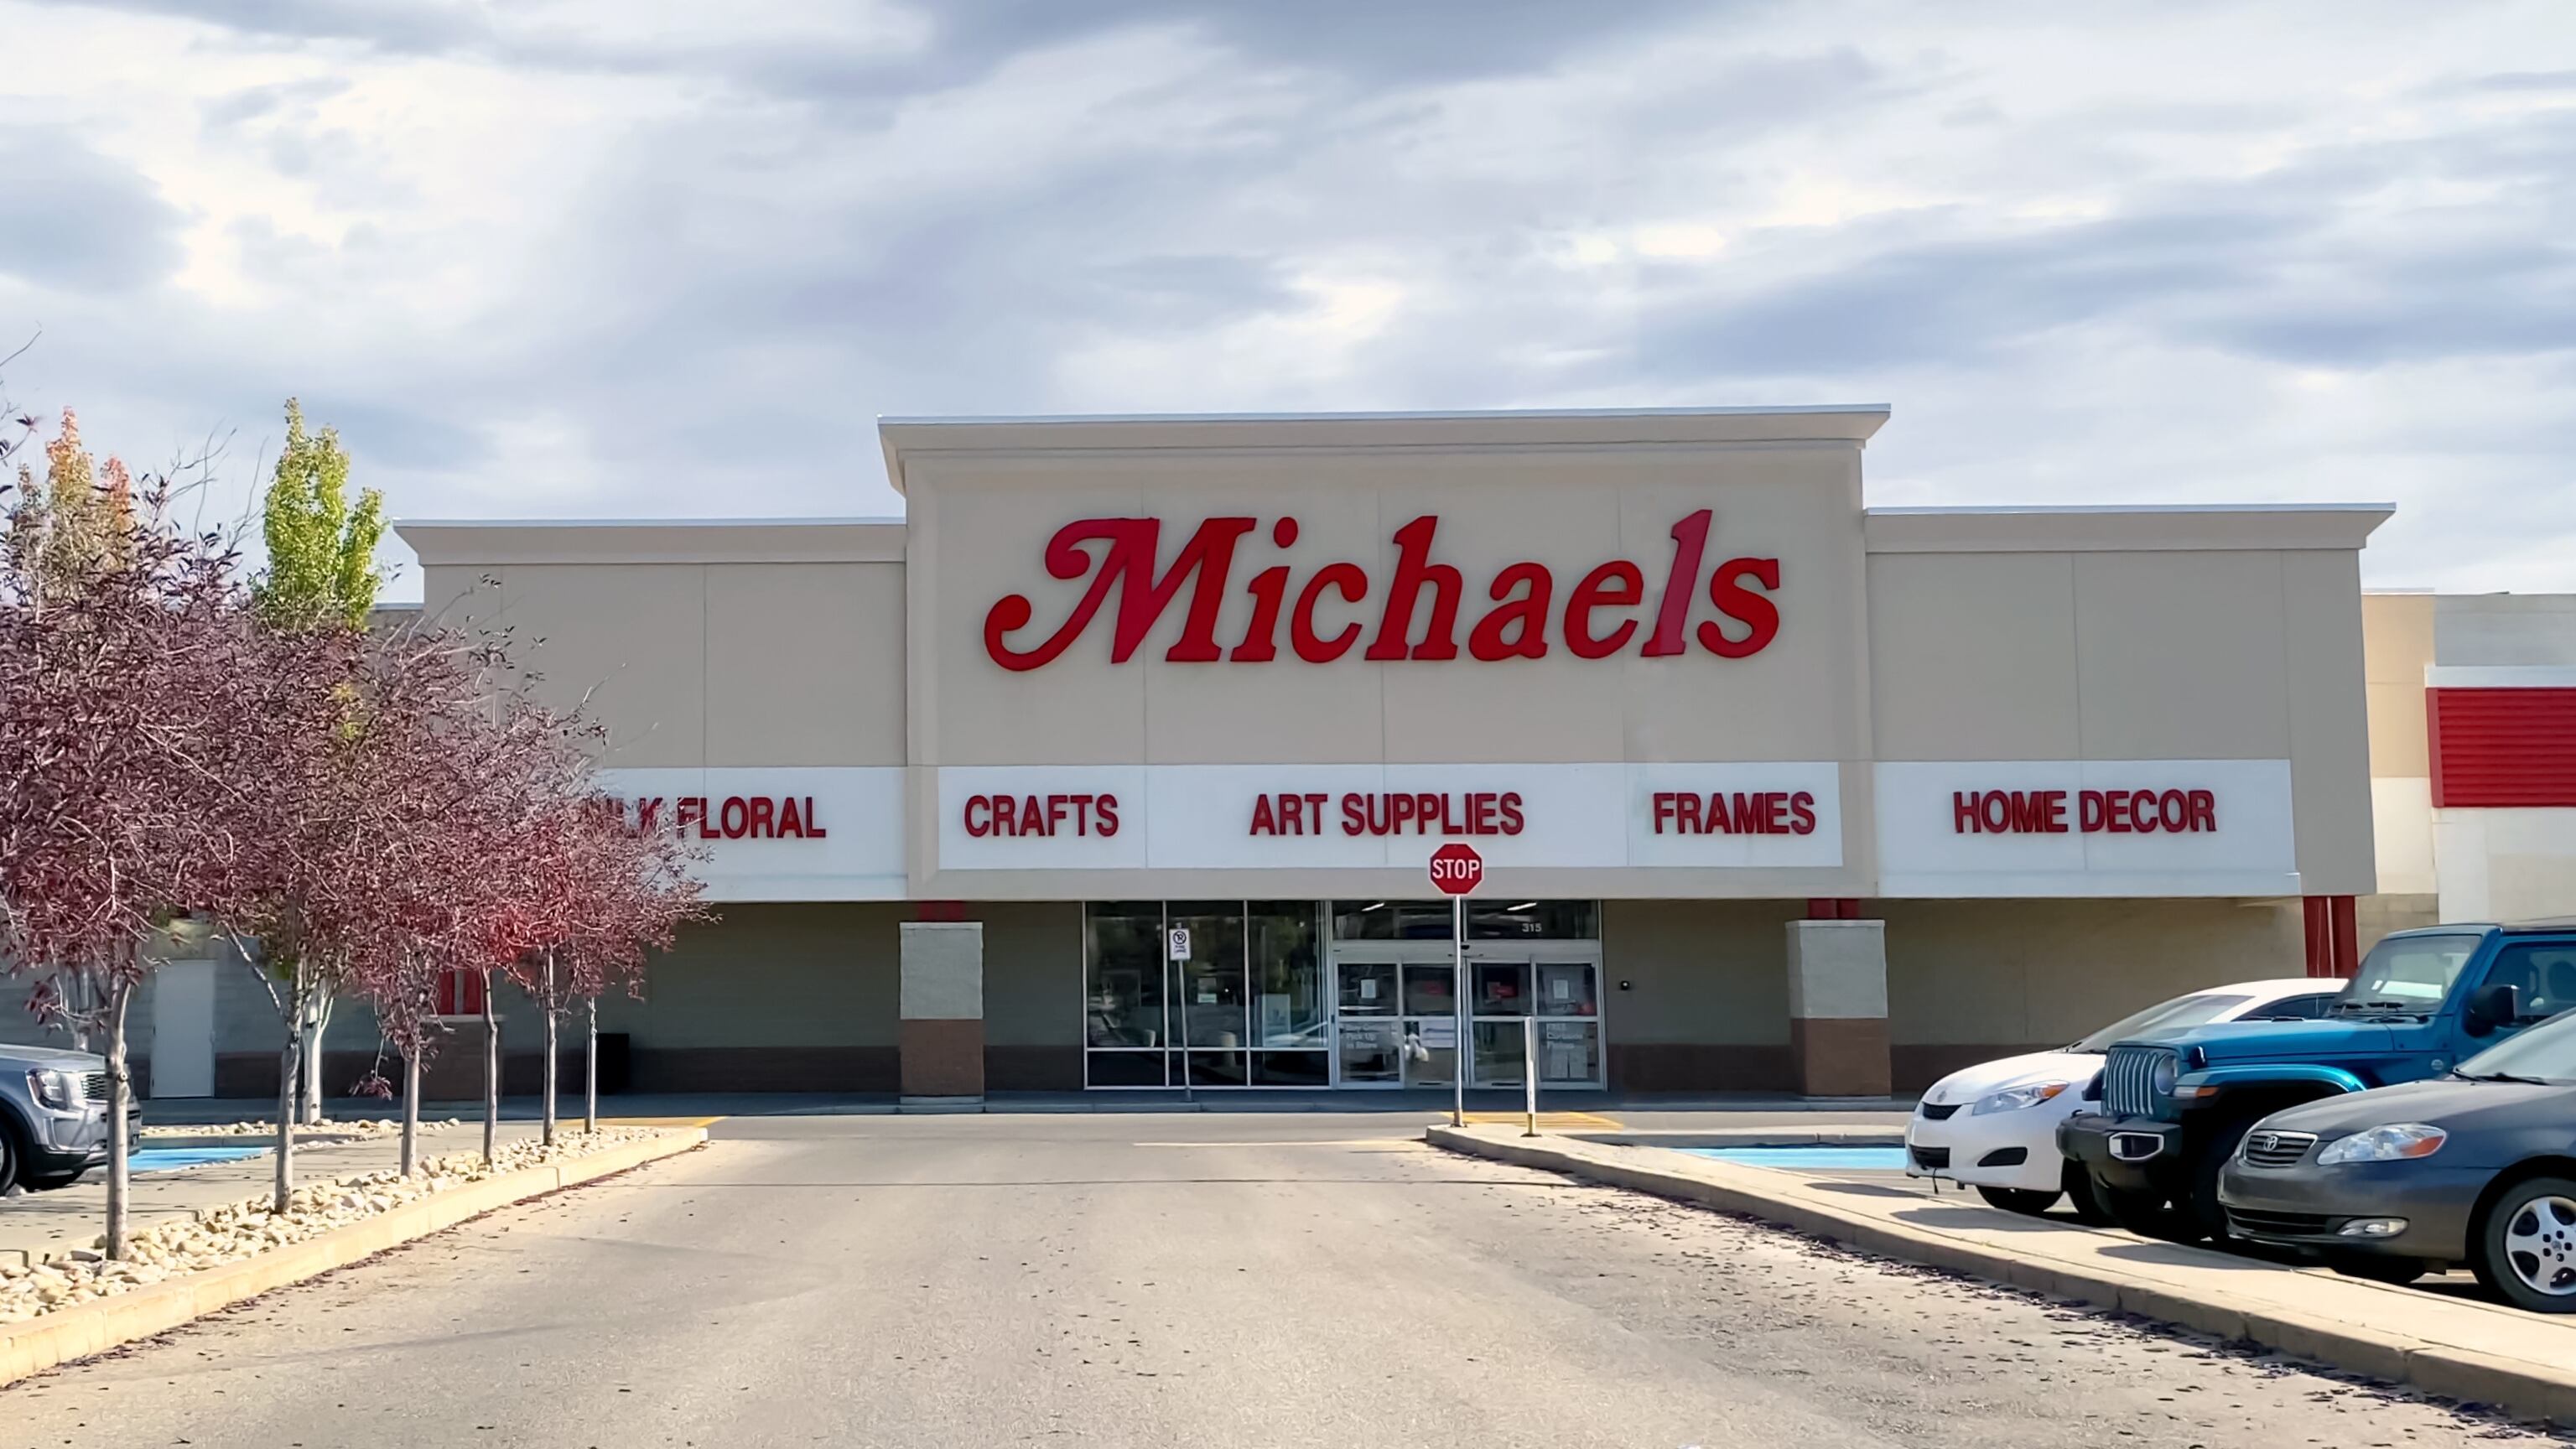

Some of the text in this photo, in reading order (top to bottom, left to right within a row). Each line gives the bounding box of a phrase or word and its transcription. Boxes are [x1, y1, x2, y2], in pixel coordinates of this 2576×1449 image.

[984, 508, 1780, 673] Michaels
[677, 796, 826, 839] FLORAL
[964, 794, 1119, 836] CRAFTS
[1249, 792, 1524, 836] ART SUPPLIES
[1654, 792, 1815, 835] FRAMES
[1953, 789, 2216, 834] HOME DECOR
[1432, 859, 1480, 880] STOP
[1521, 923, 1542, 932] 315
